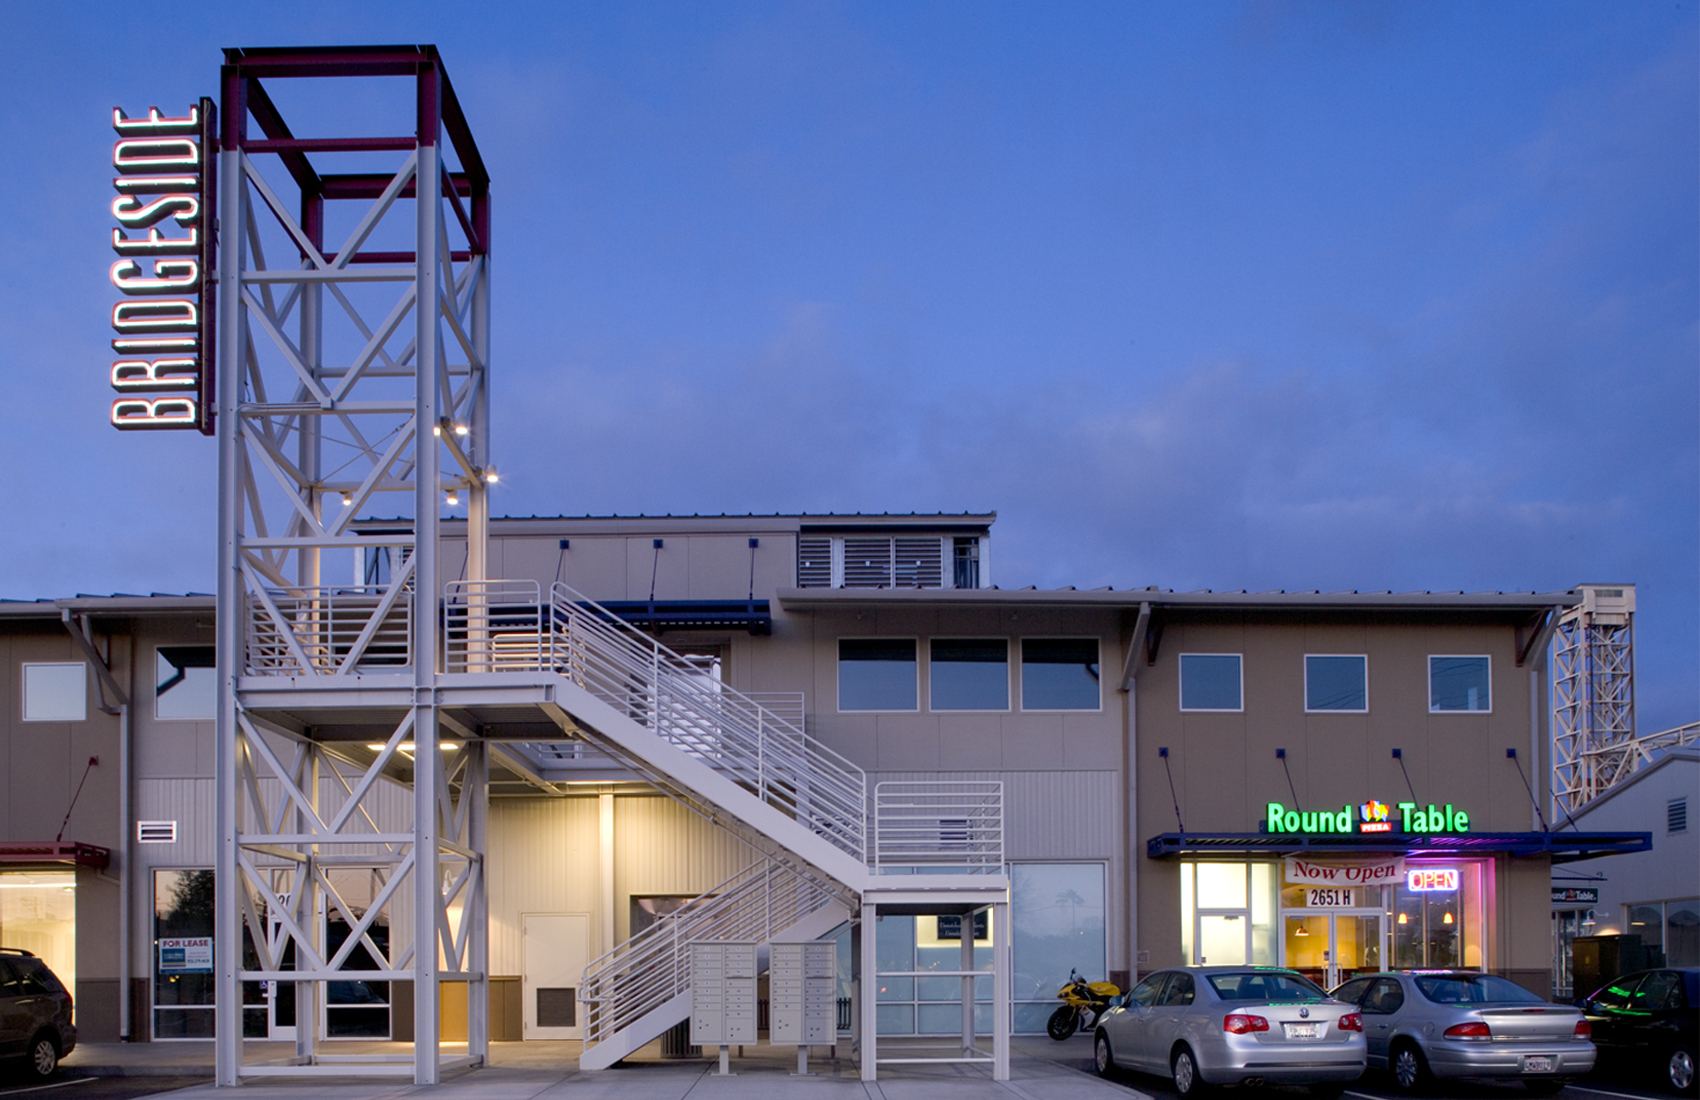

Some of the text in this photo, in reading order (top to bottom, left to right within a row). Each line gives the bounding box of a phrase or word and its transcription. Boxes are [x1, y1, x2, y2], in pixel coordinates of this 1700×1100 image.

[110, 104, 199, 431] BRIDGESIDE
[1267, 802, 1469, 833] Round Table
[1361, 823, 1391, 832] PIZZA
[1293, 861, 1396, 883] Now Open
[1411, 871, 1454, 889] OPEN
[1311, 889, 1351, 905] 2651 H
[183, 939, 209, 947] LEASE
